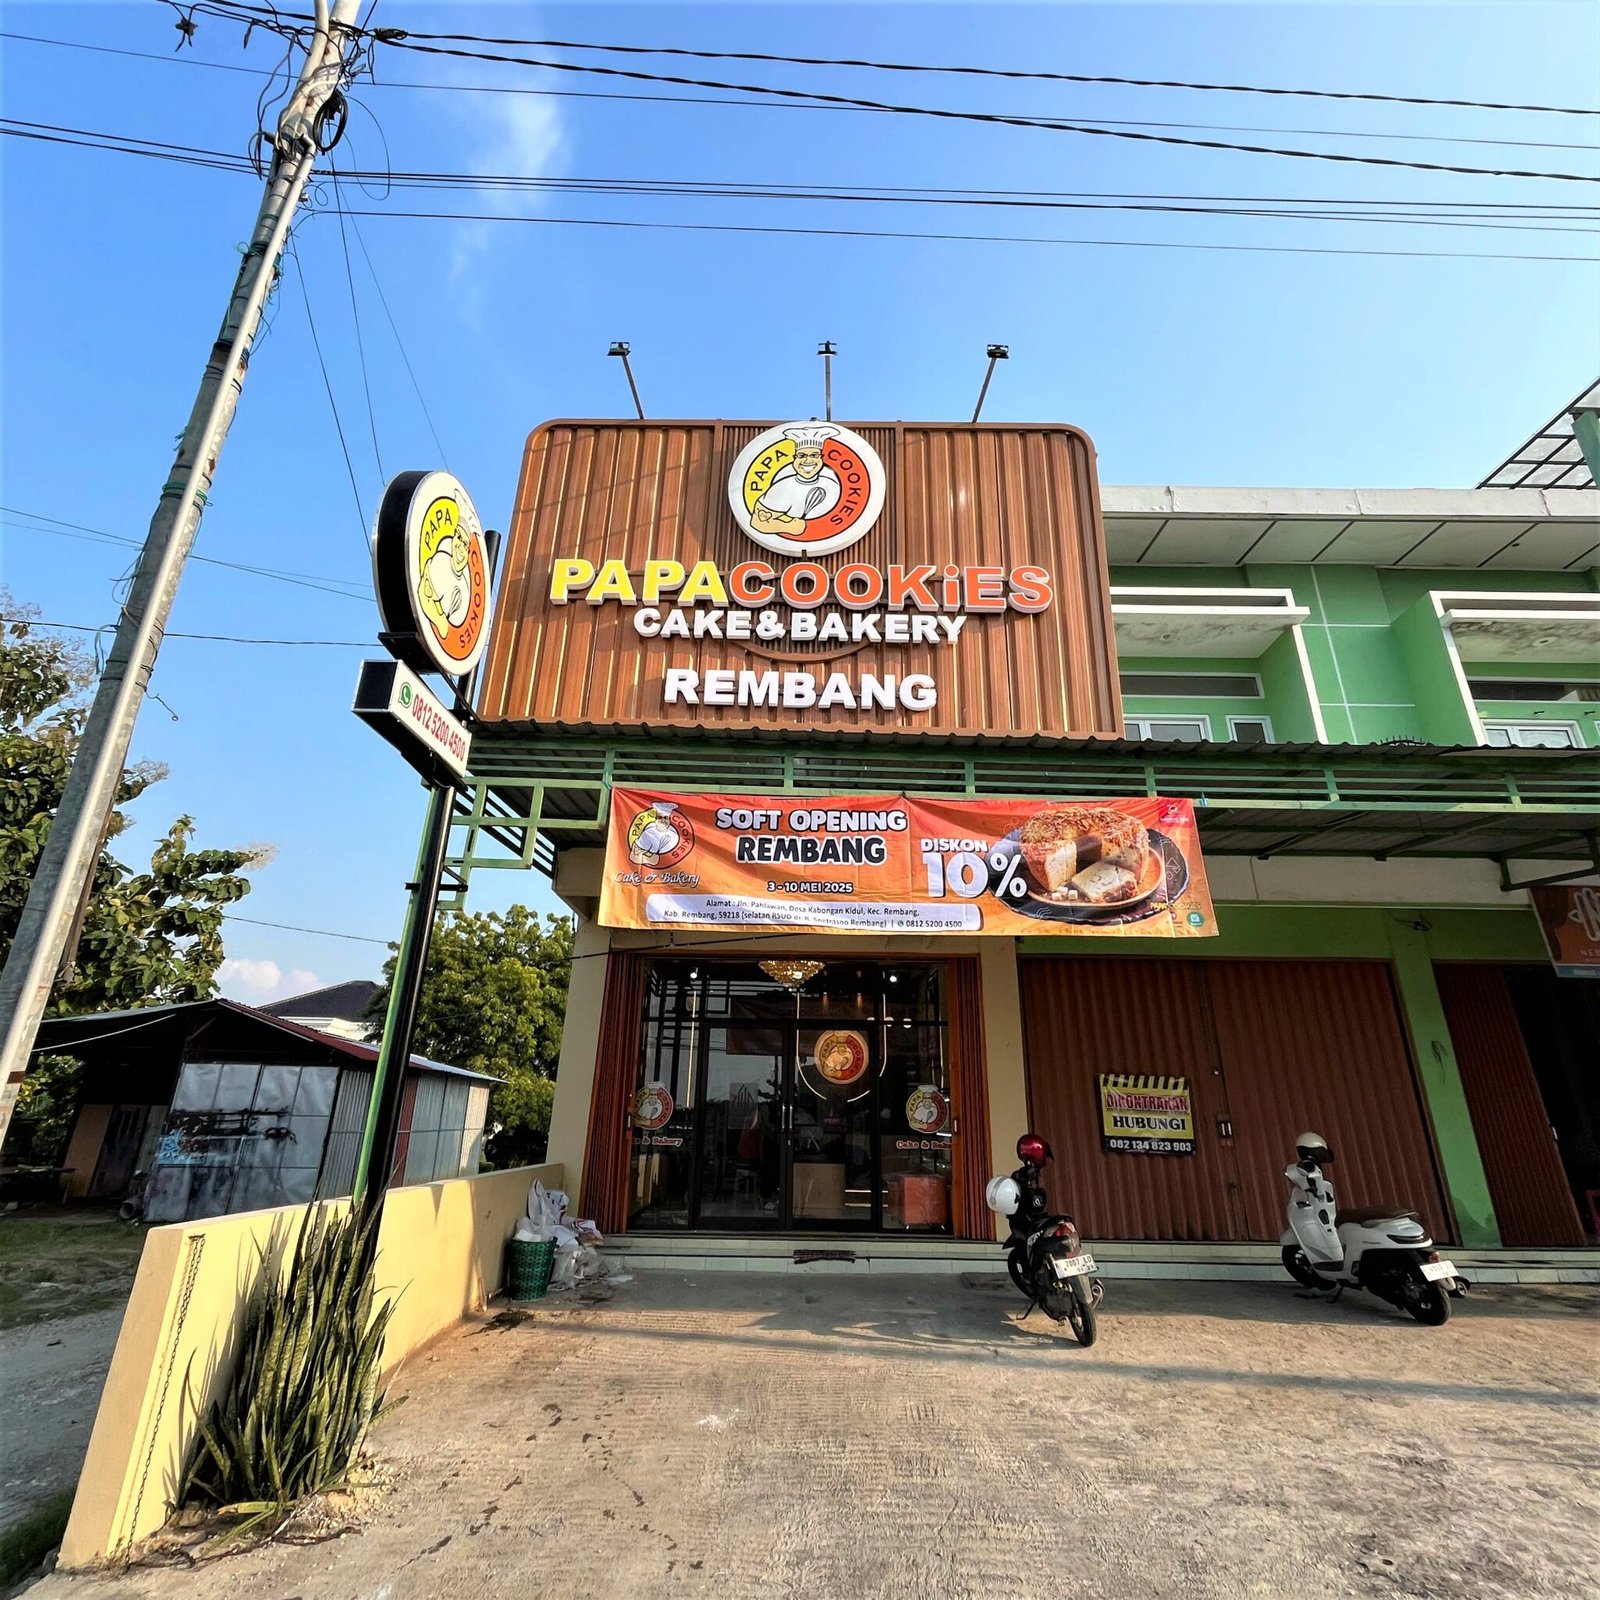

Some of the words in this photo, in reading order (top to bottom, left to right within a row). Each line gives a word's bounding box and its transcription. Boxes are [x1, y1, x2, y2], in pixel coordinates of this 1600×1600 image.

[750, 449, 788, 492] PAPA
[828, 449, 862, 526] COOKIES
[424, 508, 453, 551] PAPA
[459, 550, 482, 649] COOKIES
[664, 668, 937, 712] REMBANG
[412, 693, 433, 731] 0812
[431, 712, 450, 747] 5200
[449, 730, 466, 762] 4500
[715, 807, 782, 831] SOFT
[789, 809, 908, 832] OPENING
[632, 812, 656, 837] PAPA
[672, 815, 690, 859] COOKIES
[920, 838, 988, 852] DISKON
[736, 835, 887, 865] REMBANG
[615, 870, 641, 886] Cake
[645, 872, 657, 883] &
[661, 870, 699, 888] Bakery
[922, 852, 1028, 898] 10%
[799, 882, 822, 893] MEI
[823, 882, 853, 894] 2025
[681, 911, 717, 920] Rembang,
[718, 911, 740, 919] 59218
[742, 911, 770, 920] (selatan
[850, 919, 886, 928] Rembang)
[905, 920, 923, 928] 0812
[925, 920, 943, 928] 5200
[944, 920, 962, 928] 4500
[706, 899, 731, 907] Alamat
[789, 905, 806, 913] Desa
[808, 907, 844, 916] Kabongan
[845, 907, 866, 916] Kidul,
[884, 908, 920, 917] Rembang,
[1112, 1115, 1186, 1130] HUBUNGI
[1110, 1139, 1130, 1149] 082
[1131, 1140, 1150, 1150] 134
[1173, 1142, 1191, 1151] 903
